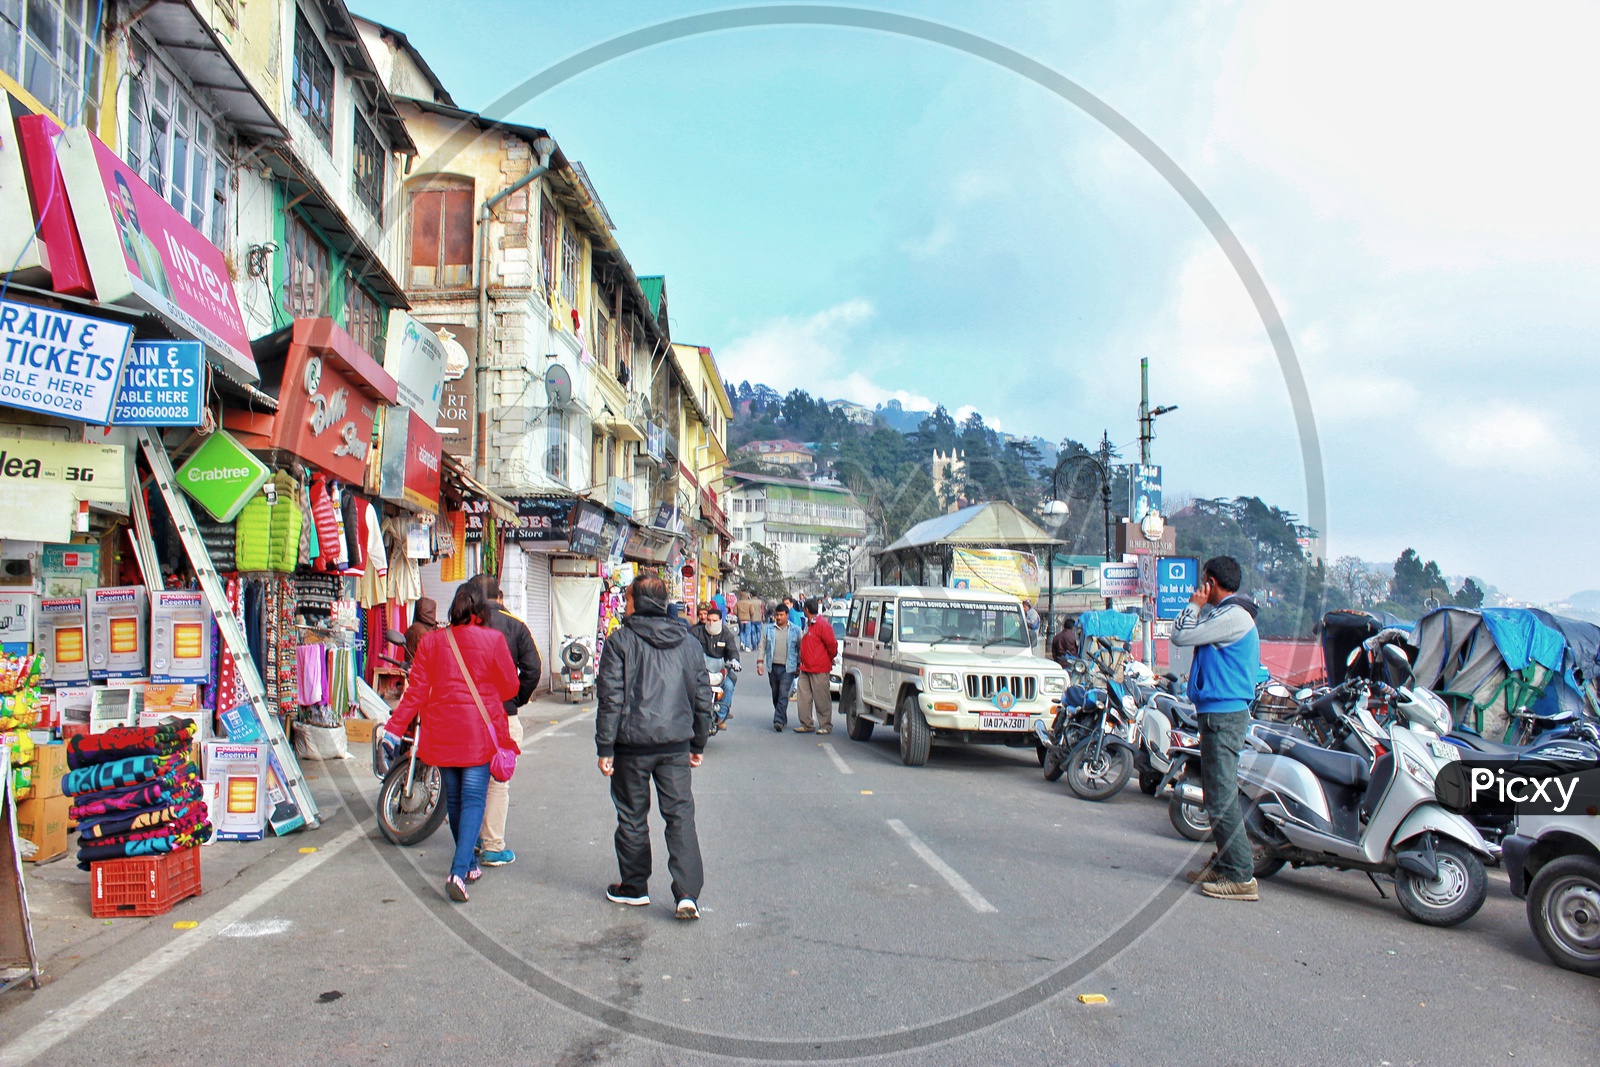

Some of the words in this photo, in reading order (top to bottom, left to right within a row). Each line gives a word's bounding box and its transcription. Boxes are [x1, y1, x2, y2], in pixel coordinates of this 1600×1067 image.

[177, 274, 242, 336] SMARTPHONE
[79, 323, 98, 350] &
[6, 337, 115, 381] TICKETS
[167, 347, 179, 368] &
[47, 377, 96, 398] HERE
[157, 391, 189, 403] HERE
[448, 394, 467, 407] RT
[116, 406, 189, 419] 7500600028
[65, 466, 94, 482] 3G
[187, 466, 250, 482] Crabtree
[518, 529, 544, 538] Store
[1159, 584, 1168, 593] State
[1169, 584, 1179, 593] Bank
[1180, 584, 1184, 593] of
[1185, 584, 1195, 593] India
[901, 600, 927, 608] CENTRAL
[987, 604, 1018, 612] MUSSOORIE
[217, 751, 256, 759] Essentia
